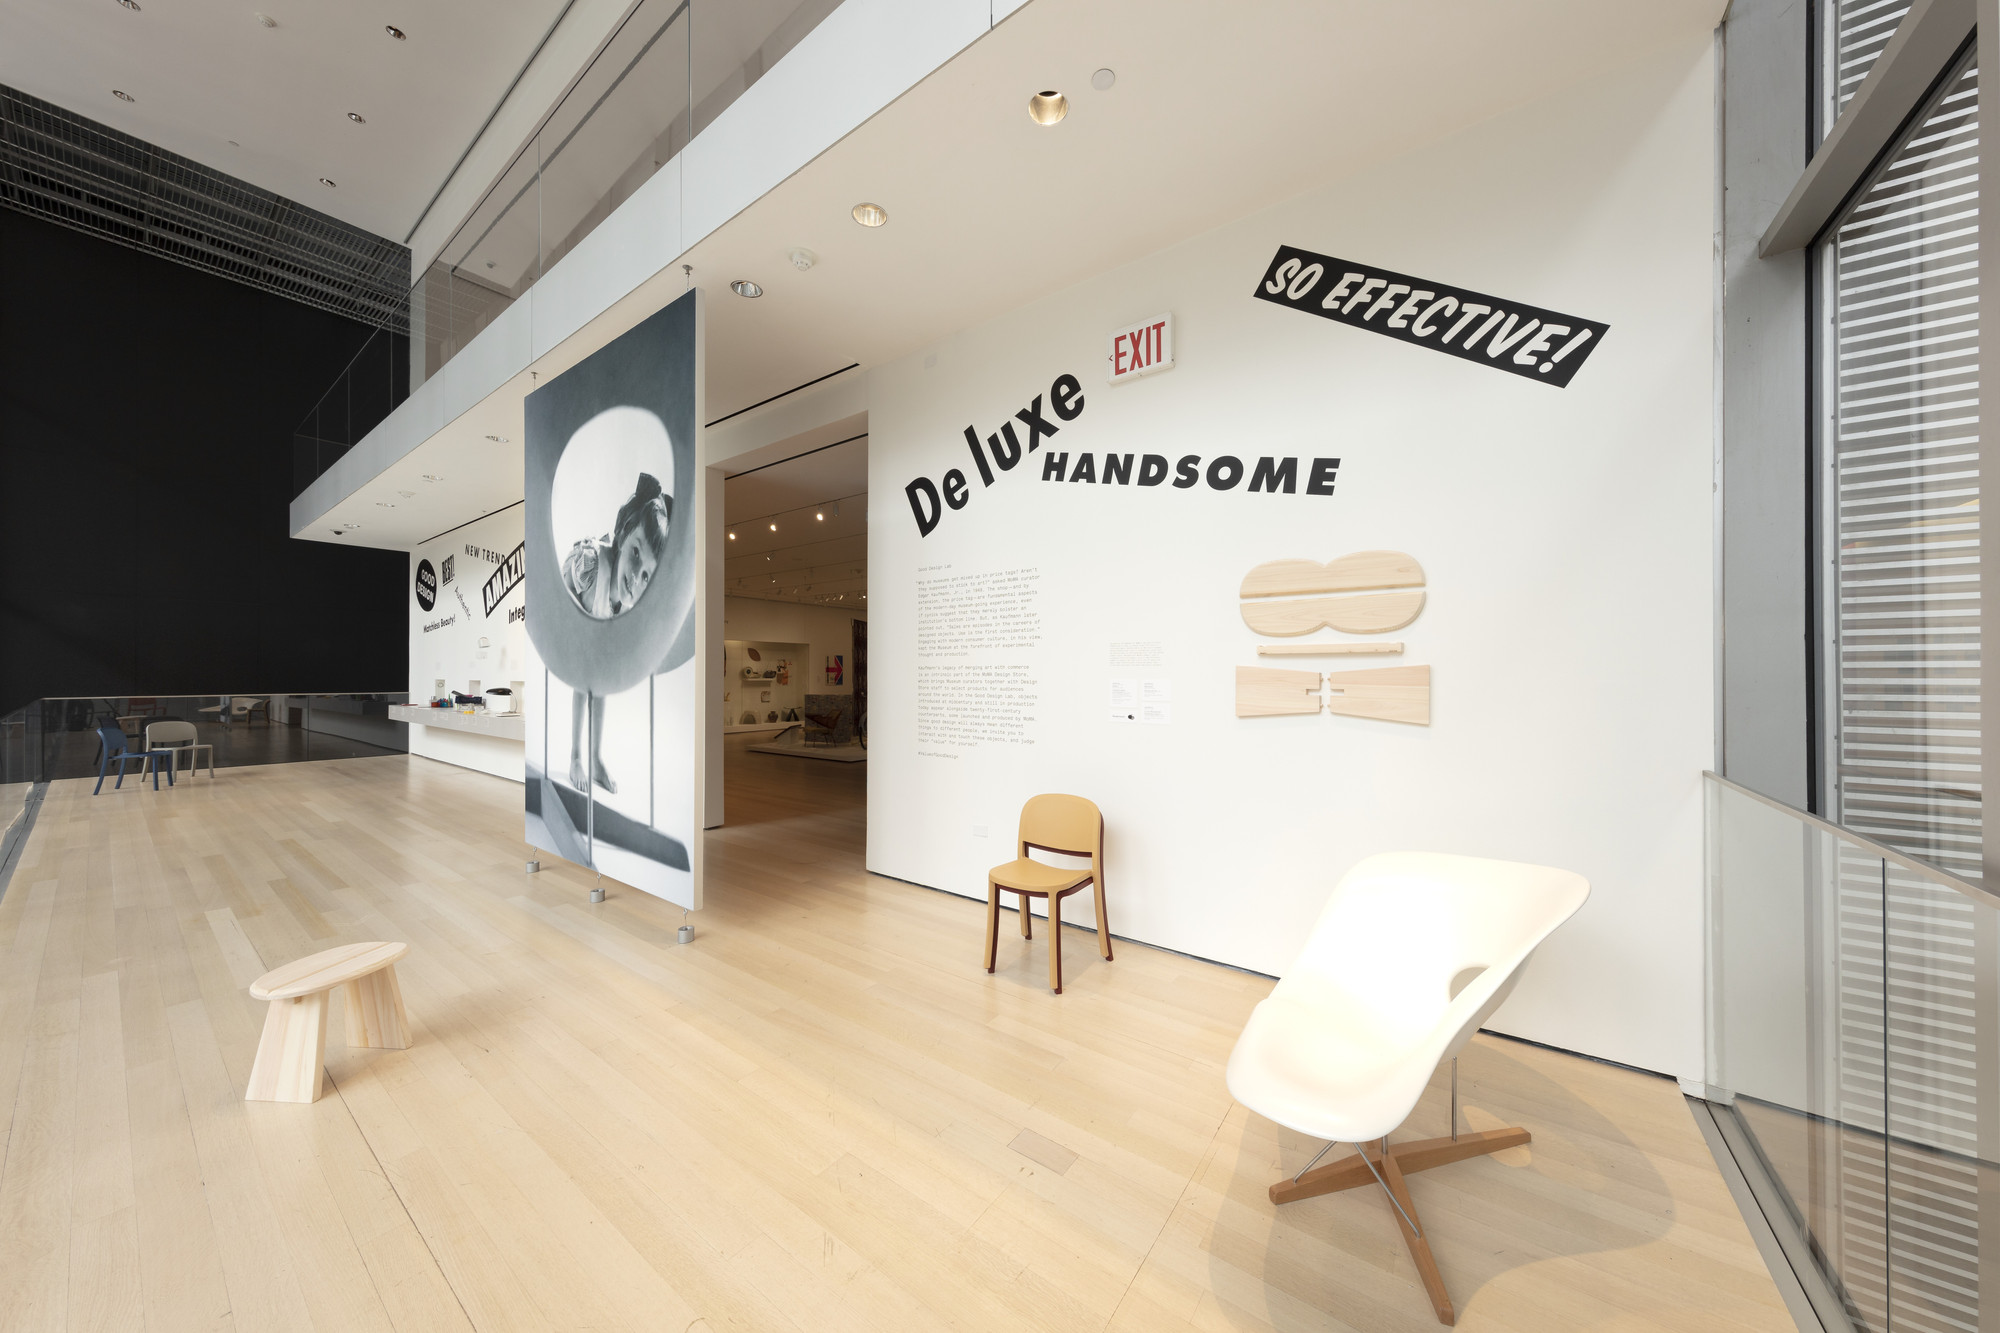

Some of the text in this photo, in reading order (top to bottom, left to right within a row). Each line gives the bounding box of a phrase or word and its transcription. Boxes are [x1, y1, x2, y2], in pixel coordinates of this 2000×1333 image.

[1266, 257, 1593, 374] SO EFFECTIVE!
[1114, 320, 1166, 376] EXIT
[1041, 451, 1342, 496] HANDSOME
[465, 544, 480, 558] NEW
[421, 570, 435, 587] GOOD
[417, 582, 434, 603] DESIGN
[424, 614, 456, 633] Matchless Beauty!
